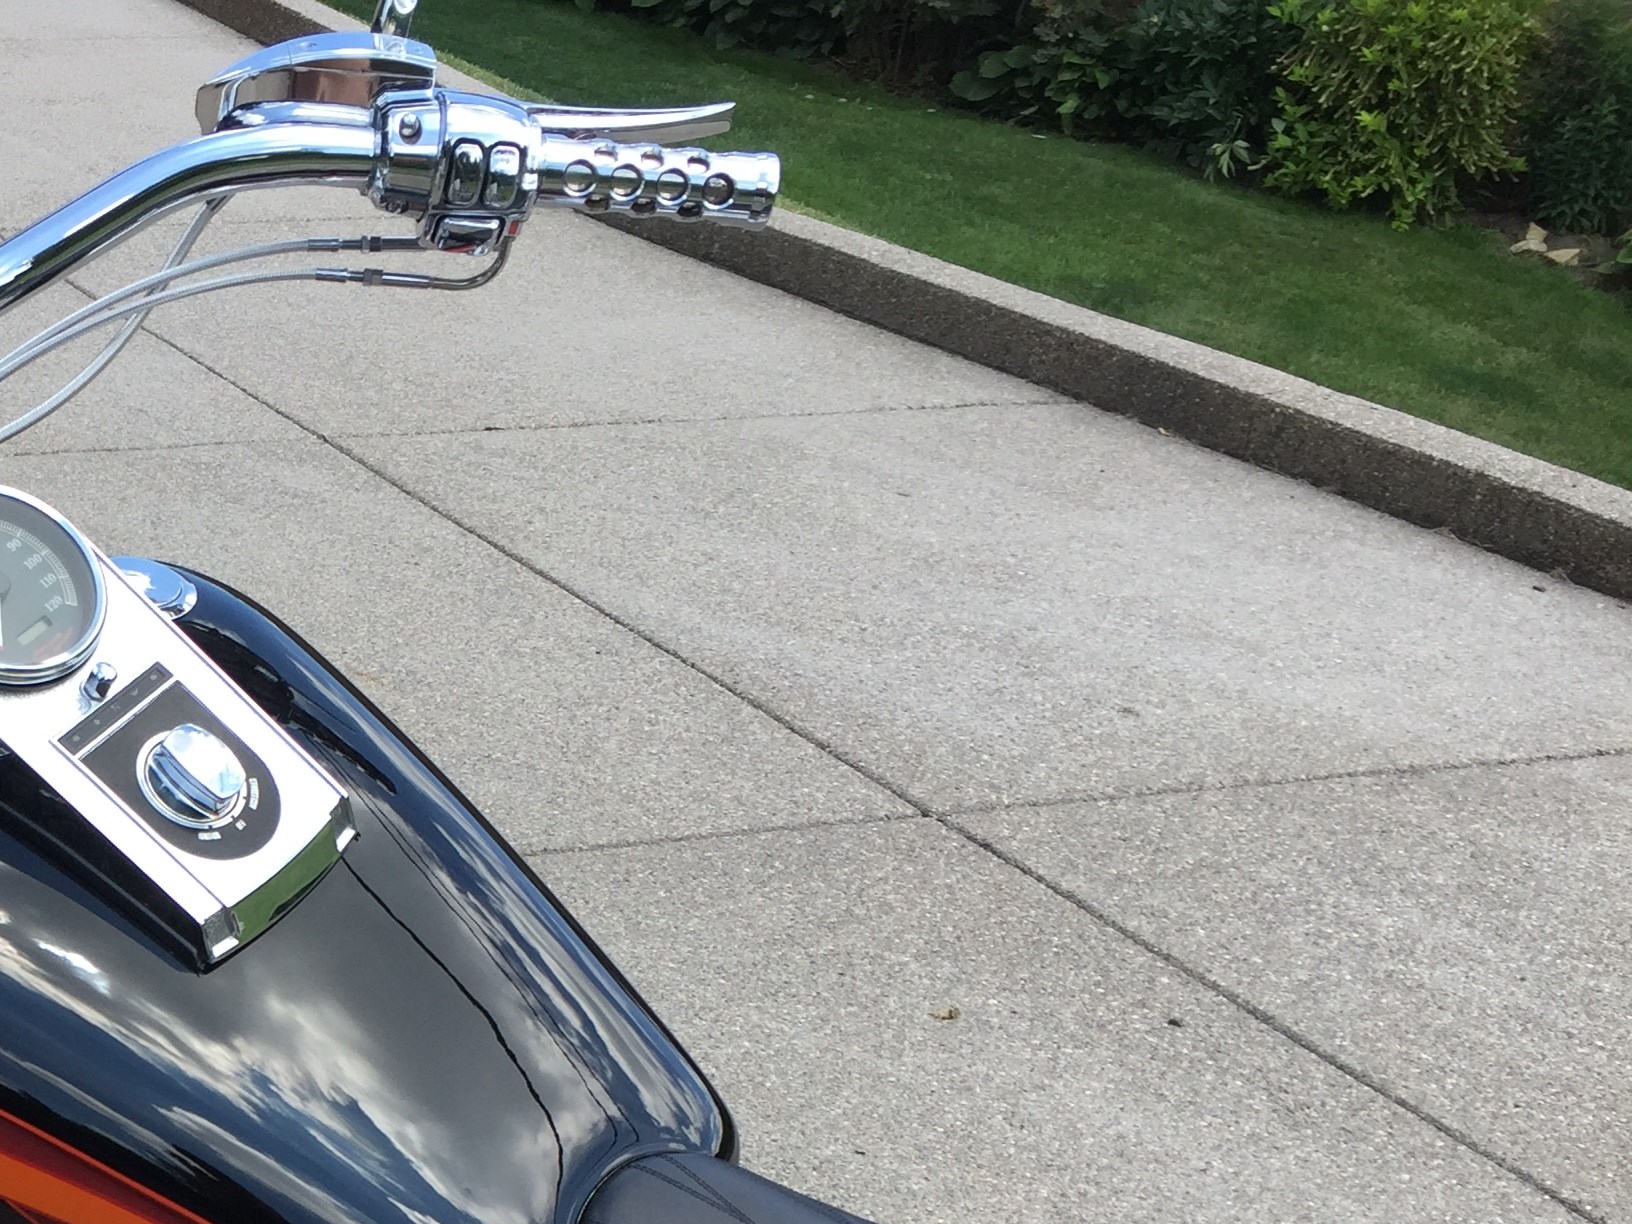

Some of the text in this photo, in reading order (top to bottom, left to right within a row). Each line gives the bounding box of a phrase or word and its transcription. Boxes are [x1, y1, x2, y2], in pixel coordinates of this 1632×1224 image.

[6, 538, 22, 552] 90
[23, 553, 43, 570] 100
[39, 572, 58, 589] 110
[44, 595, 63, 612] 120
